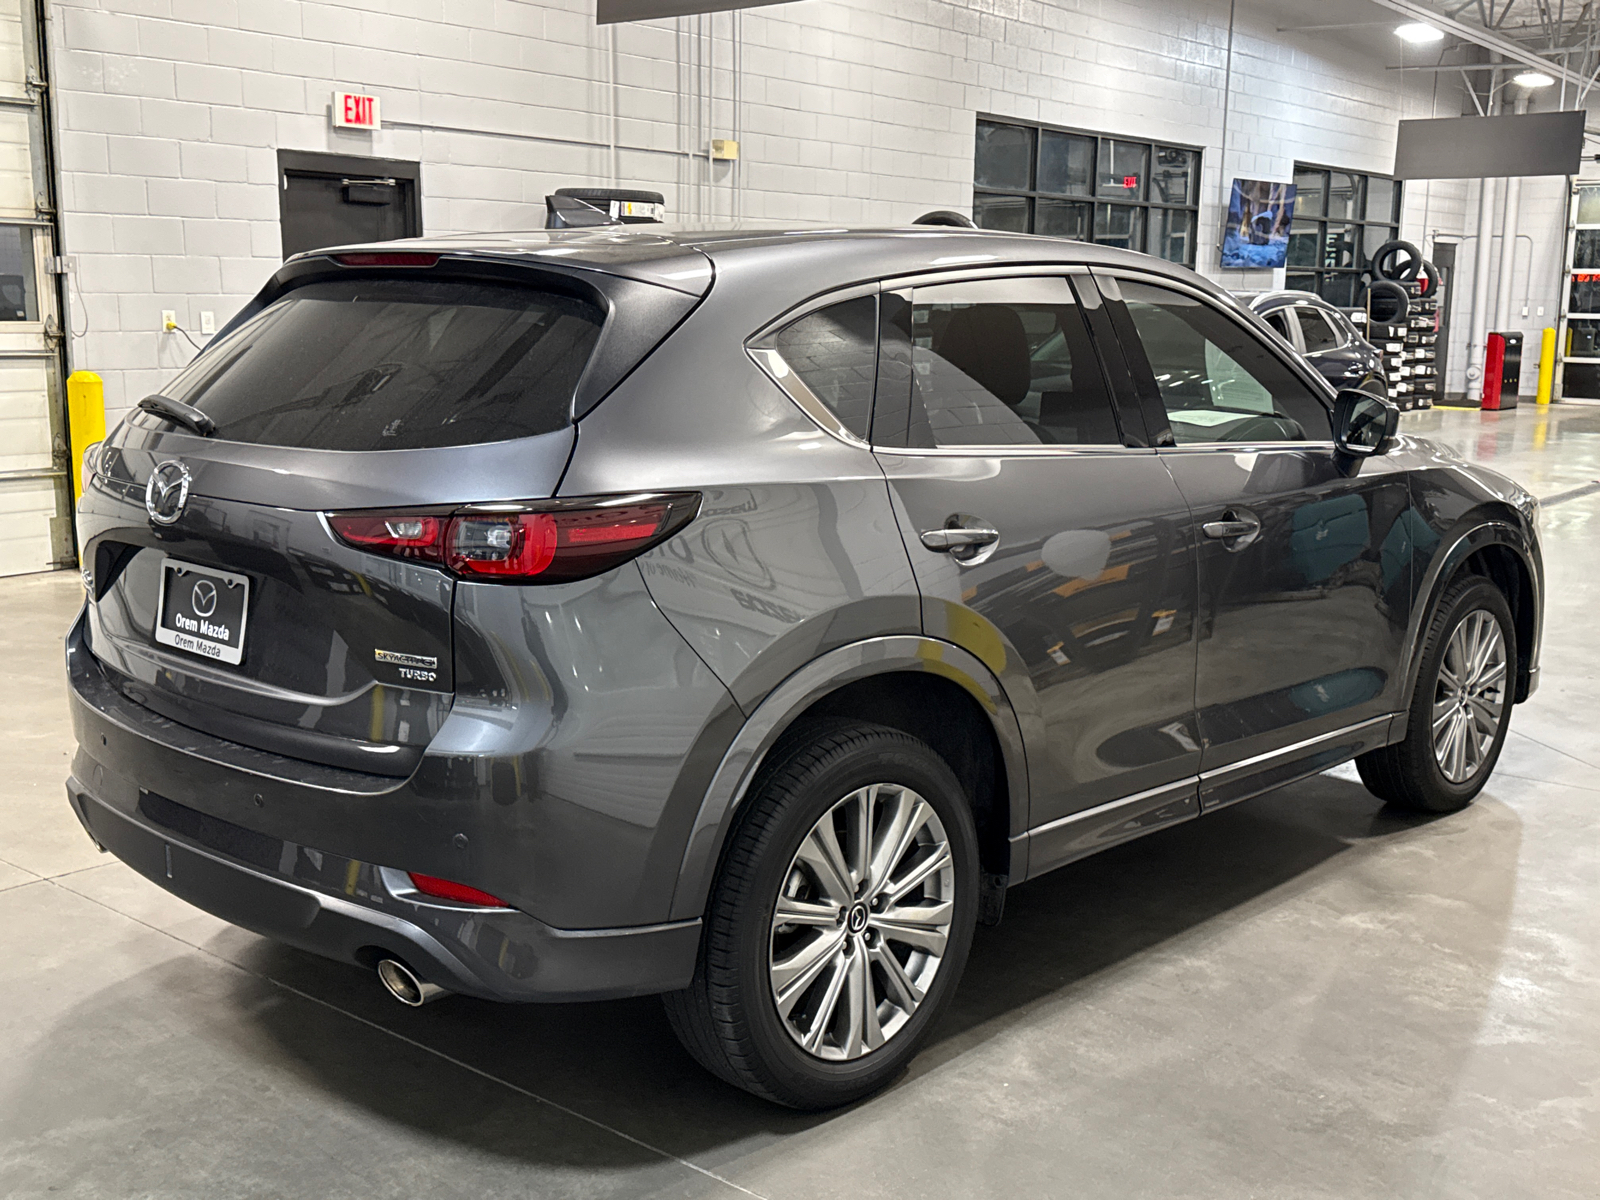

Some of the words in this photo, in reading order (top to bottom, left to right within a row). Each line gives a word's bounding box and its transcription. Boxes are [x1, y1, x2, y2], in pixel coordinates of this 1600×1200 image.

[344, 94, 374, 126] EXIT
[176, 613, 198, 632] Orem
[200, 620, 230, 641] Mazda
[175, 634, 194, 650] Orem
[196, 640, 221, 657] Mazda
[399, 667, 437, 682] TURBO
